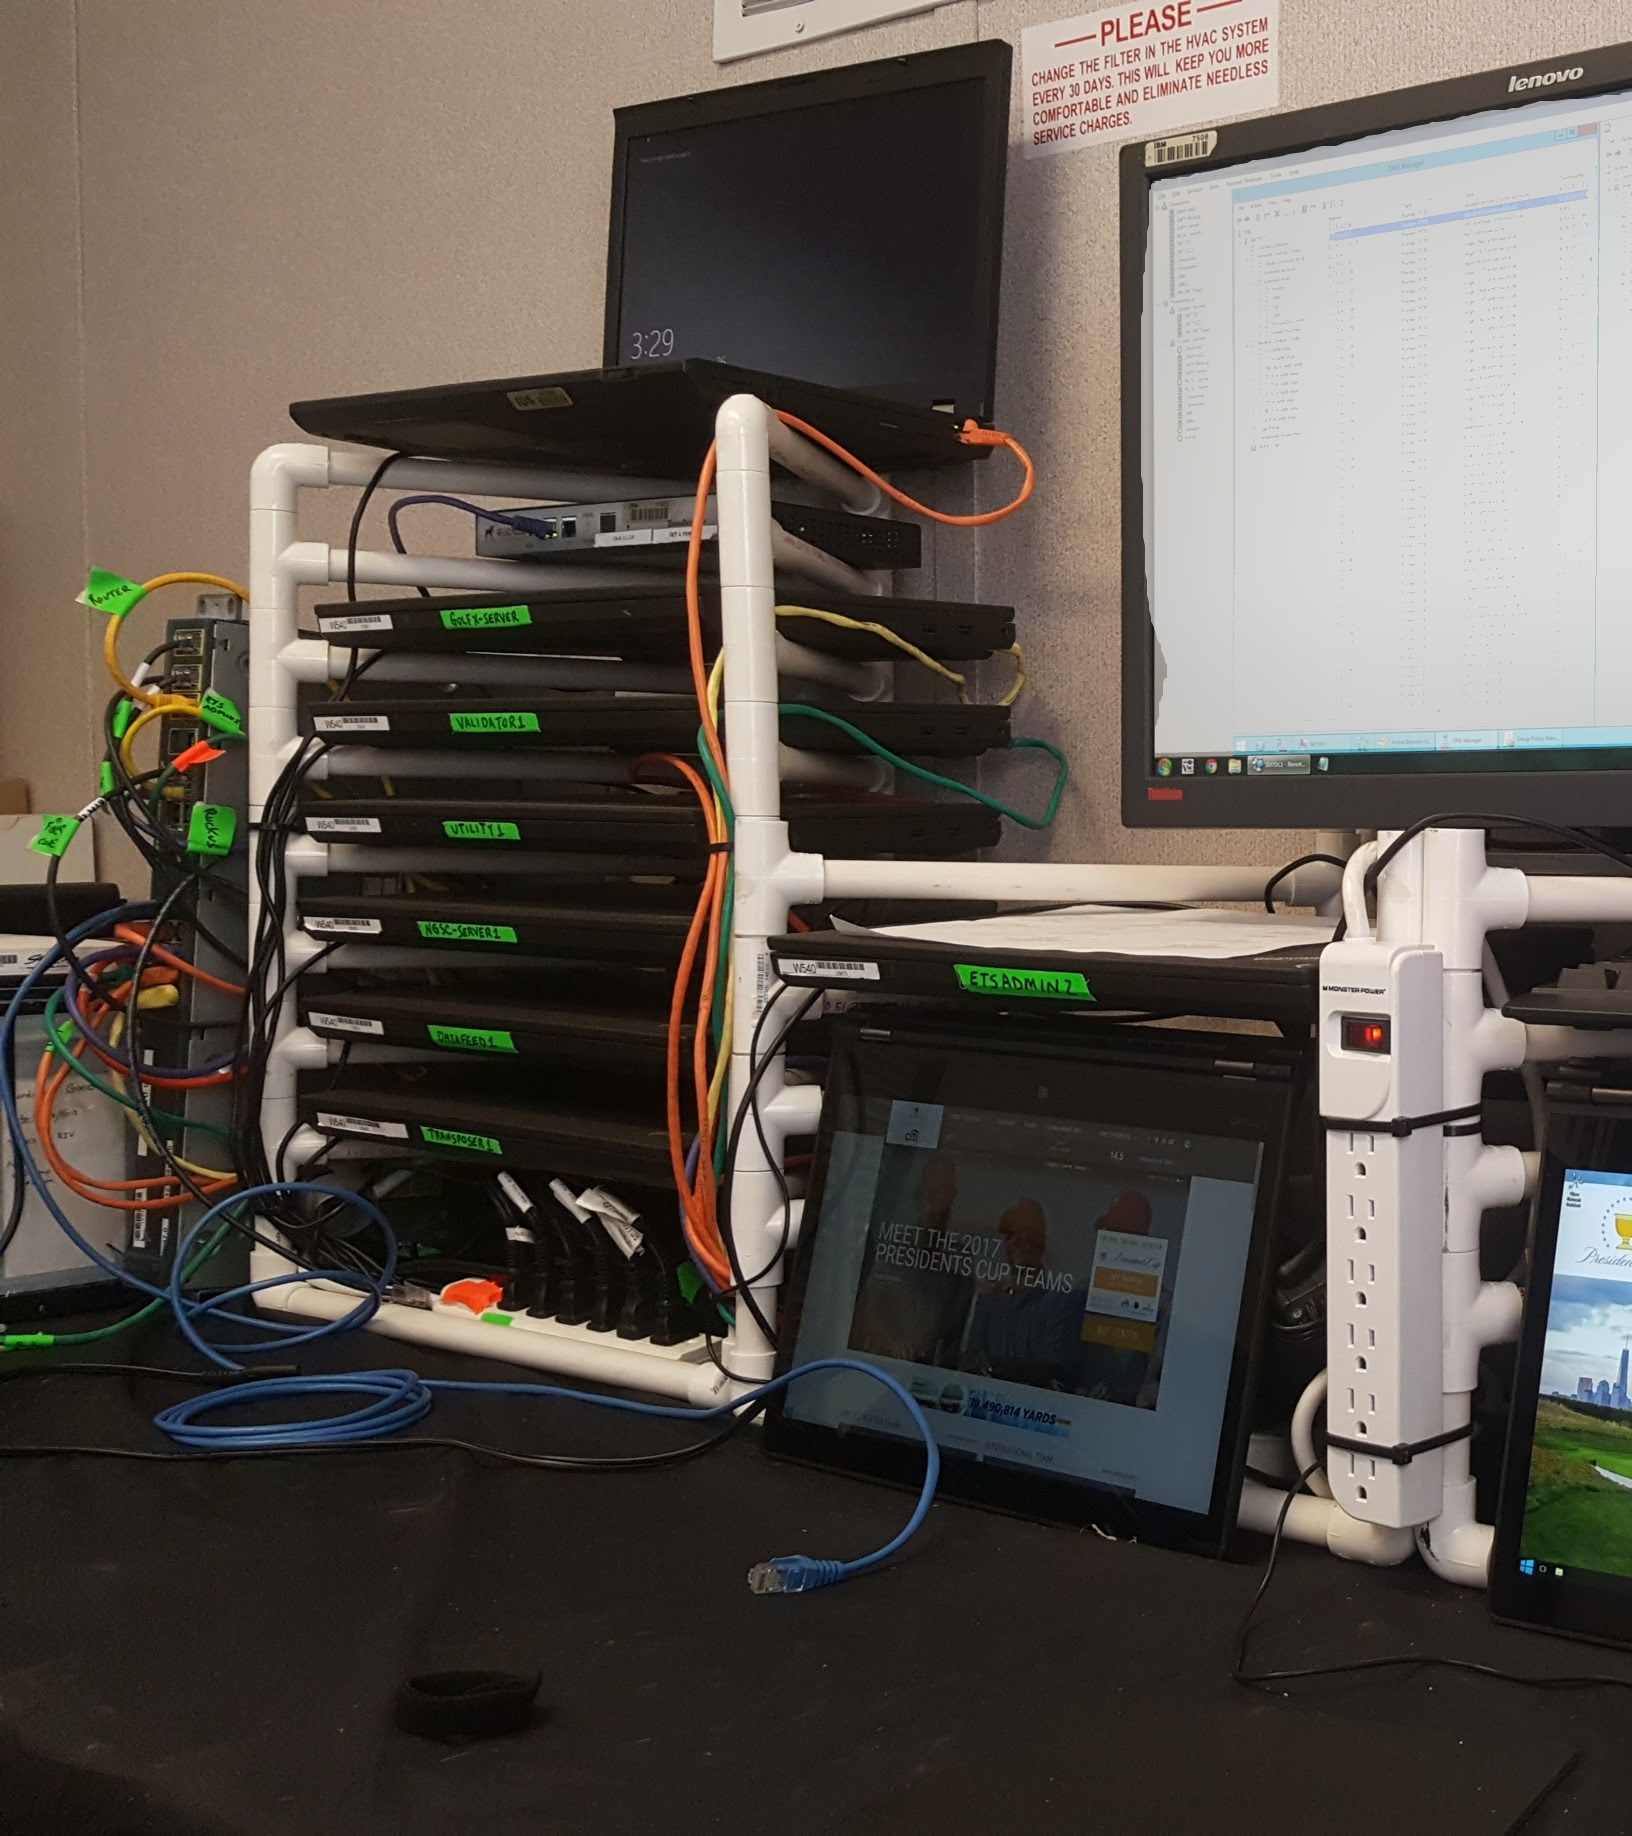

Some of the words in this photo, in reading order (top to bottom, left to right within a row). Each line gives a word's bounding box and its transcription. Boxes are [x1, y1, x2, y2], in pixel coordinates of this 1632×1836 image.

[1101, 0, 1192, 46] PLEASE
[1031, 63, 1075, 86] CHANGE
[1080, 58, 1100, 75] THE
[1104, 48, 1141, 69] FILTER
[1145, 44, 1156, 60] IN
[1160, 38, 1182, 56] THE
[1186, 30, 1217, 50] HVAC
[1221, 17, 1268, 42] SYSTEM
[1032, 85, 1065, 107] EVERY
[1069, 82, 1080, 99] 30
[1083, 75, 1114, 94] DAYS.
[1118, 68, 1141, 86] THIS
[1144, 62, 1169, 80] WILL
[1175, 54, 1204, 73] KEEP
[1208, 47, 1232, 64] YOU
[1236, 38, 1269, 60] MORE
[1507, 67, 1584, 92] lenovo
[1033, 97, 1111, 126] COMFORTABLE
[1116, 89, 1139, 107] AND
[1143, 74, 1202, 101] ELIMINATE
[1206, 59, 1268, 86] NEEDLESS
[1033, 124, 1076, 145] SERVICE
[1080, 111, 1132, 135] CHARGES.
[1154, 140, 1167, 149] IBM
[630, 328, 675, 360] 3:29
[88, 584, 133, 606] ROUTER
[455, 715, 526, 730] VALIDATOR1
[792, 962, 817, 975] W540
[1329, 985, 1360, 994] MONSTER
[878, 1221, 924, 1246] MEET
[927, 1228, 959, 1252] THE
[961, 1232, 1002, 1258] 2017
[875, 1243, 973, 1276] PRESIDENTS
[976, 1260, 1010, 1281] CUP
[1014, 1264, 1074, 1294] TEAMS
[1022, 1403, 1057, 1426] YARDS
